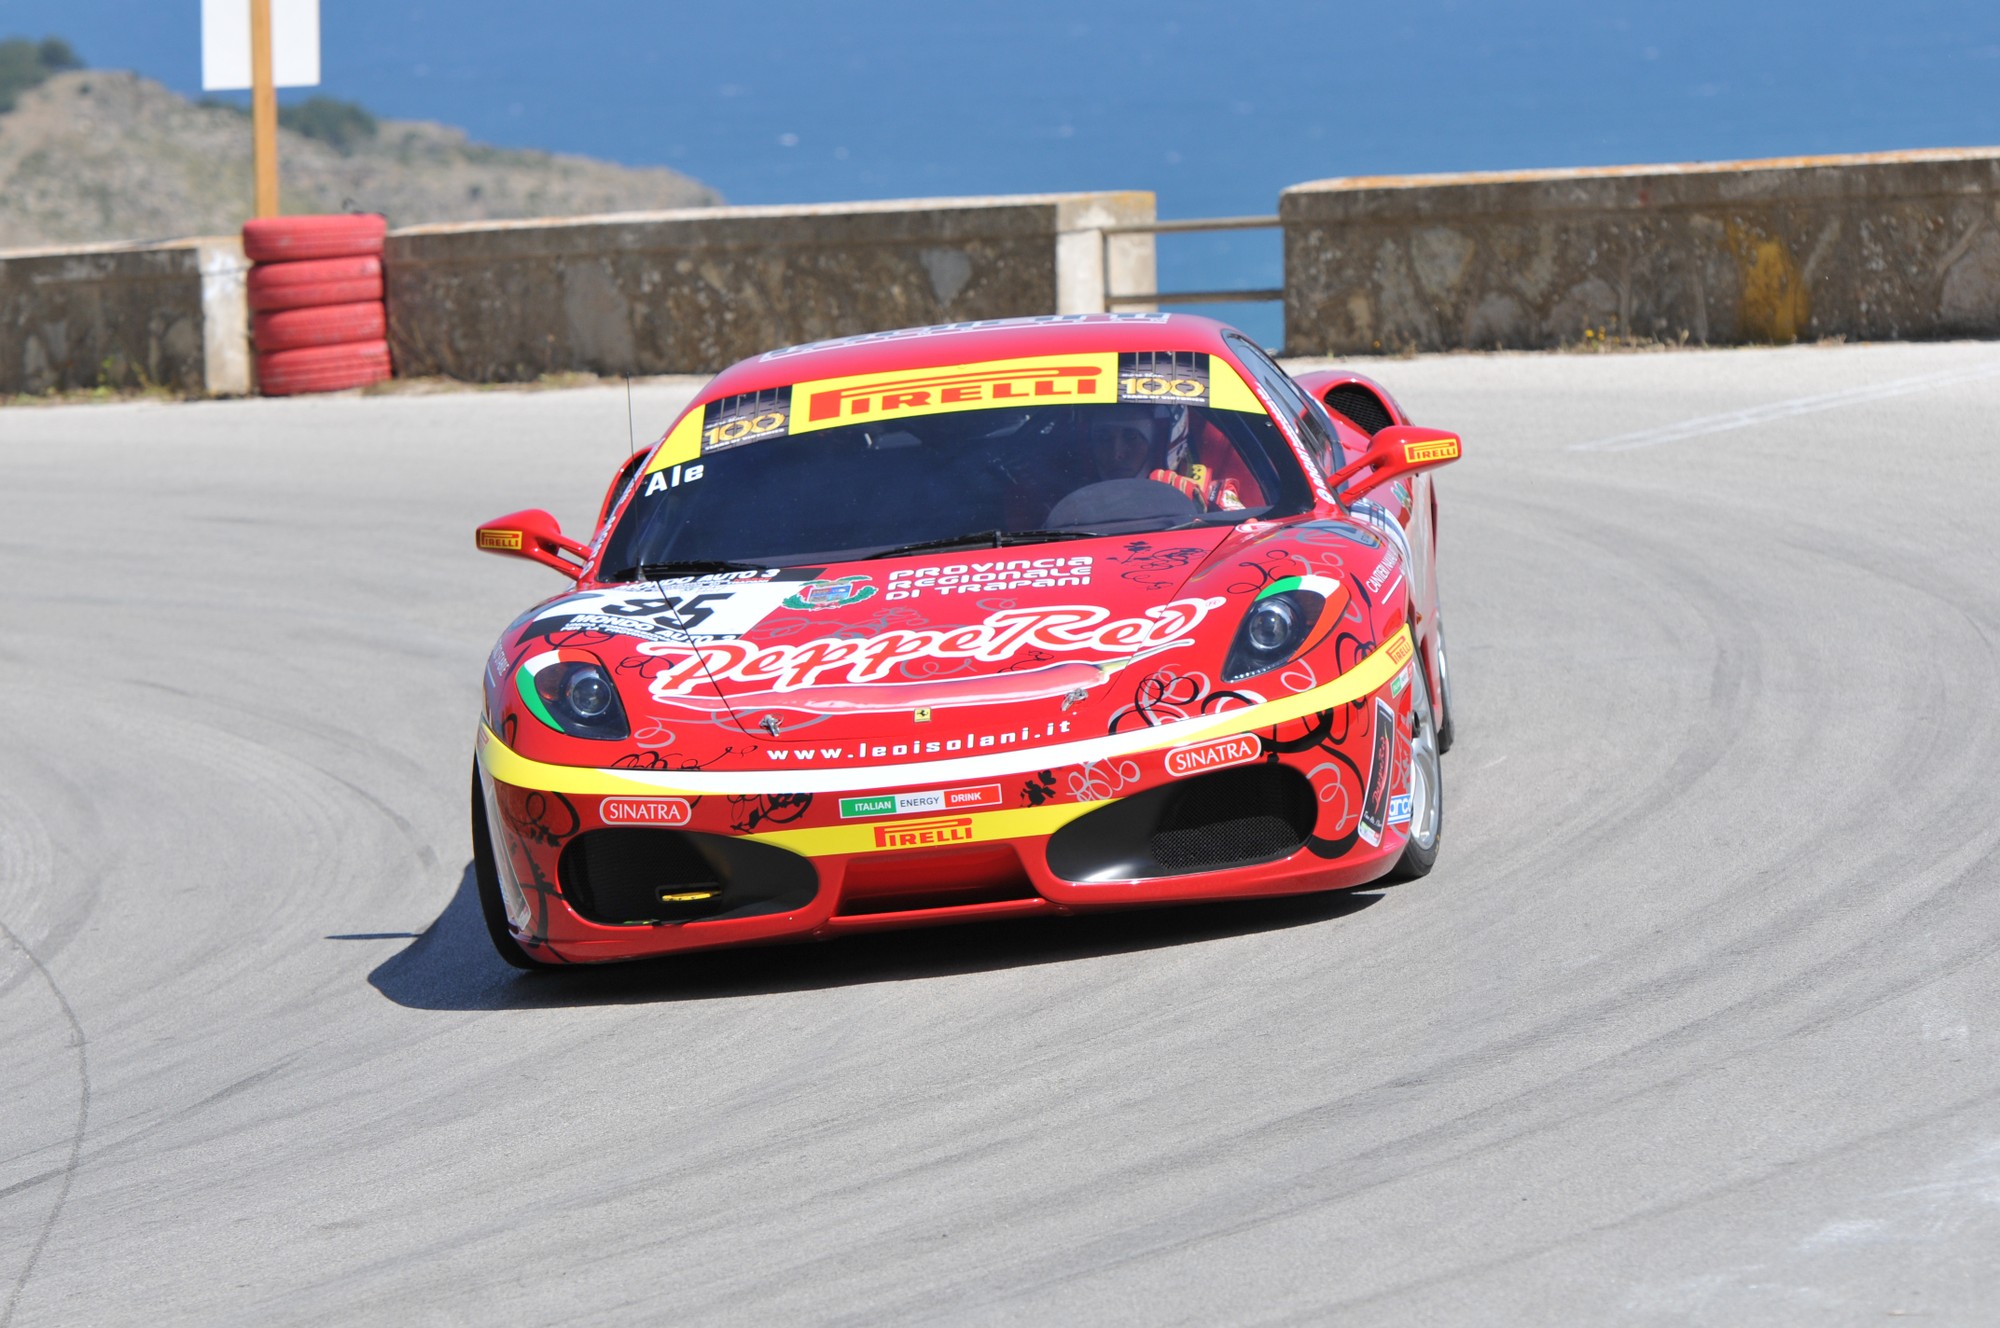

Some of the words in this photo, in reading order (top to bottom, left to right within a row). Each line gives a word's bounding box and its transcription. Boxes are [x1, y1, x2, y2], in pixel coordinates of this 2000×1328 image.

[809, 366, 1102, 422] PIRELLI
[1120, 378, 1206, 397] 100
[704, 412, 786, 446] 100
[1408, 441, 1457, 460] PIRELLI
[645, 464, 705, 497] Ale
[481, 532, 518, 547] PIRELLI
[699, 570, 758, 582] AUTO
[765, 569, 781, 578] 3
[887, 567, 1092, 590] REGIONALE
[888, 556, 1093, 581] PROVINCIA
[885, 587, 921, 600] DI
[934, 576, 1091, 597] TRAPANI
[601, 592, 736, 630] 95
[571, 614, 655, 631] MONDO
[655, 629, 715, 643] AUTO
[1385, 635, 1411, 665] PIRELLI
[767, 720, 1071, 760] www.leoisolani.it
[1176, 740, 1252, 770] SINATRA
[609, 803, 681, 820] SINATRA
[855, 799, 891, 811] ITALIAN
[900, 795, 940, 808] ENERGY
[951, 791, 981, 803] DRINK
[874, 817, 973, 847] PIRELLI
